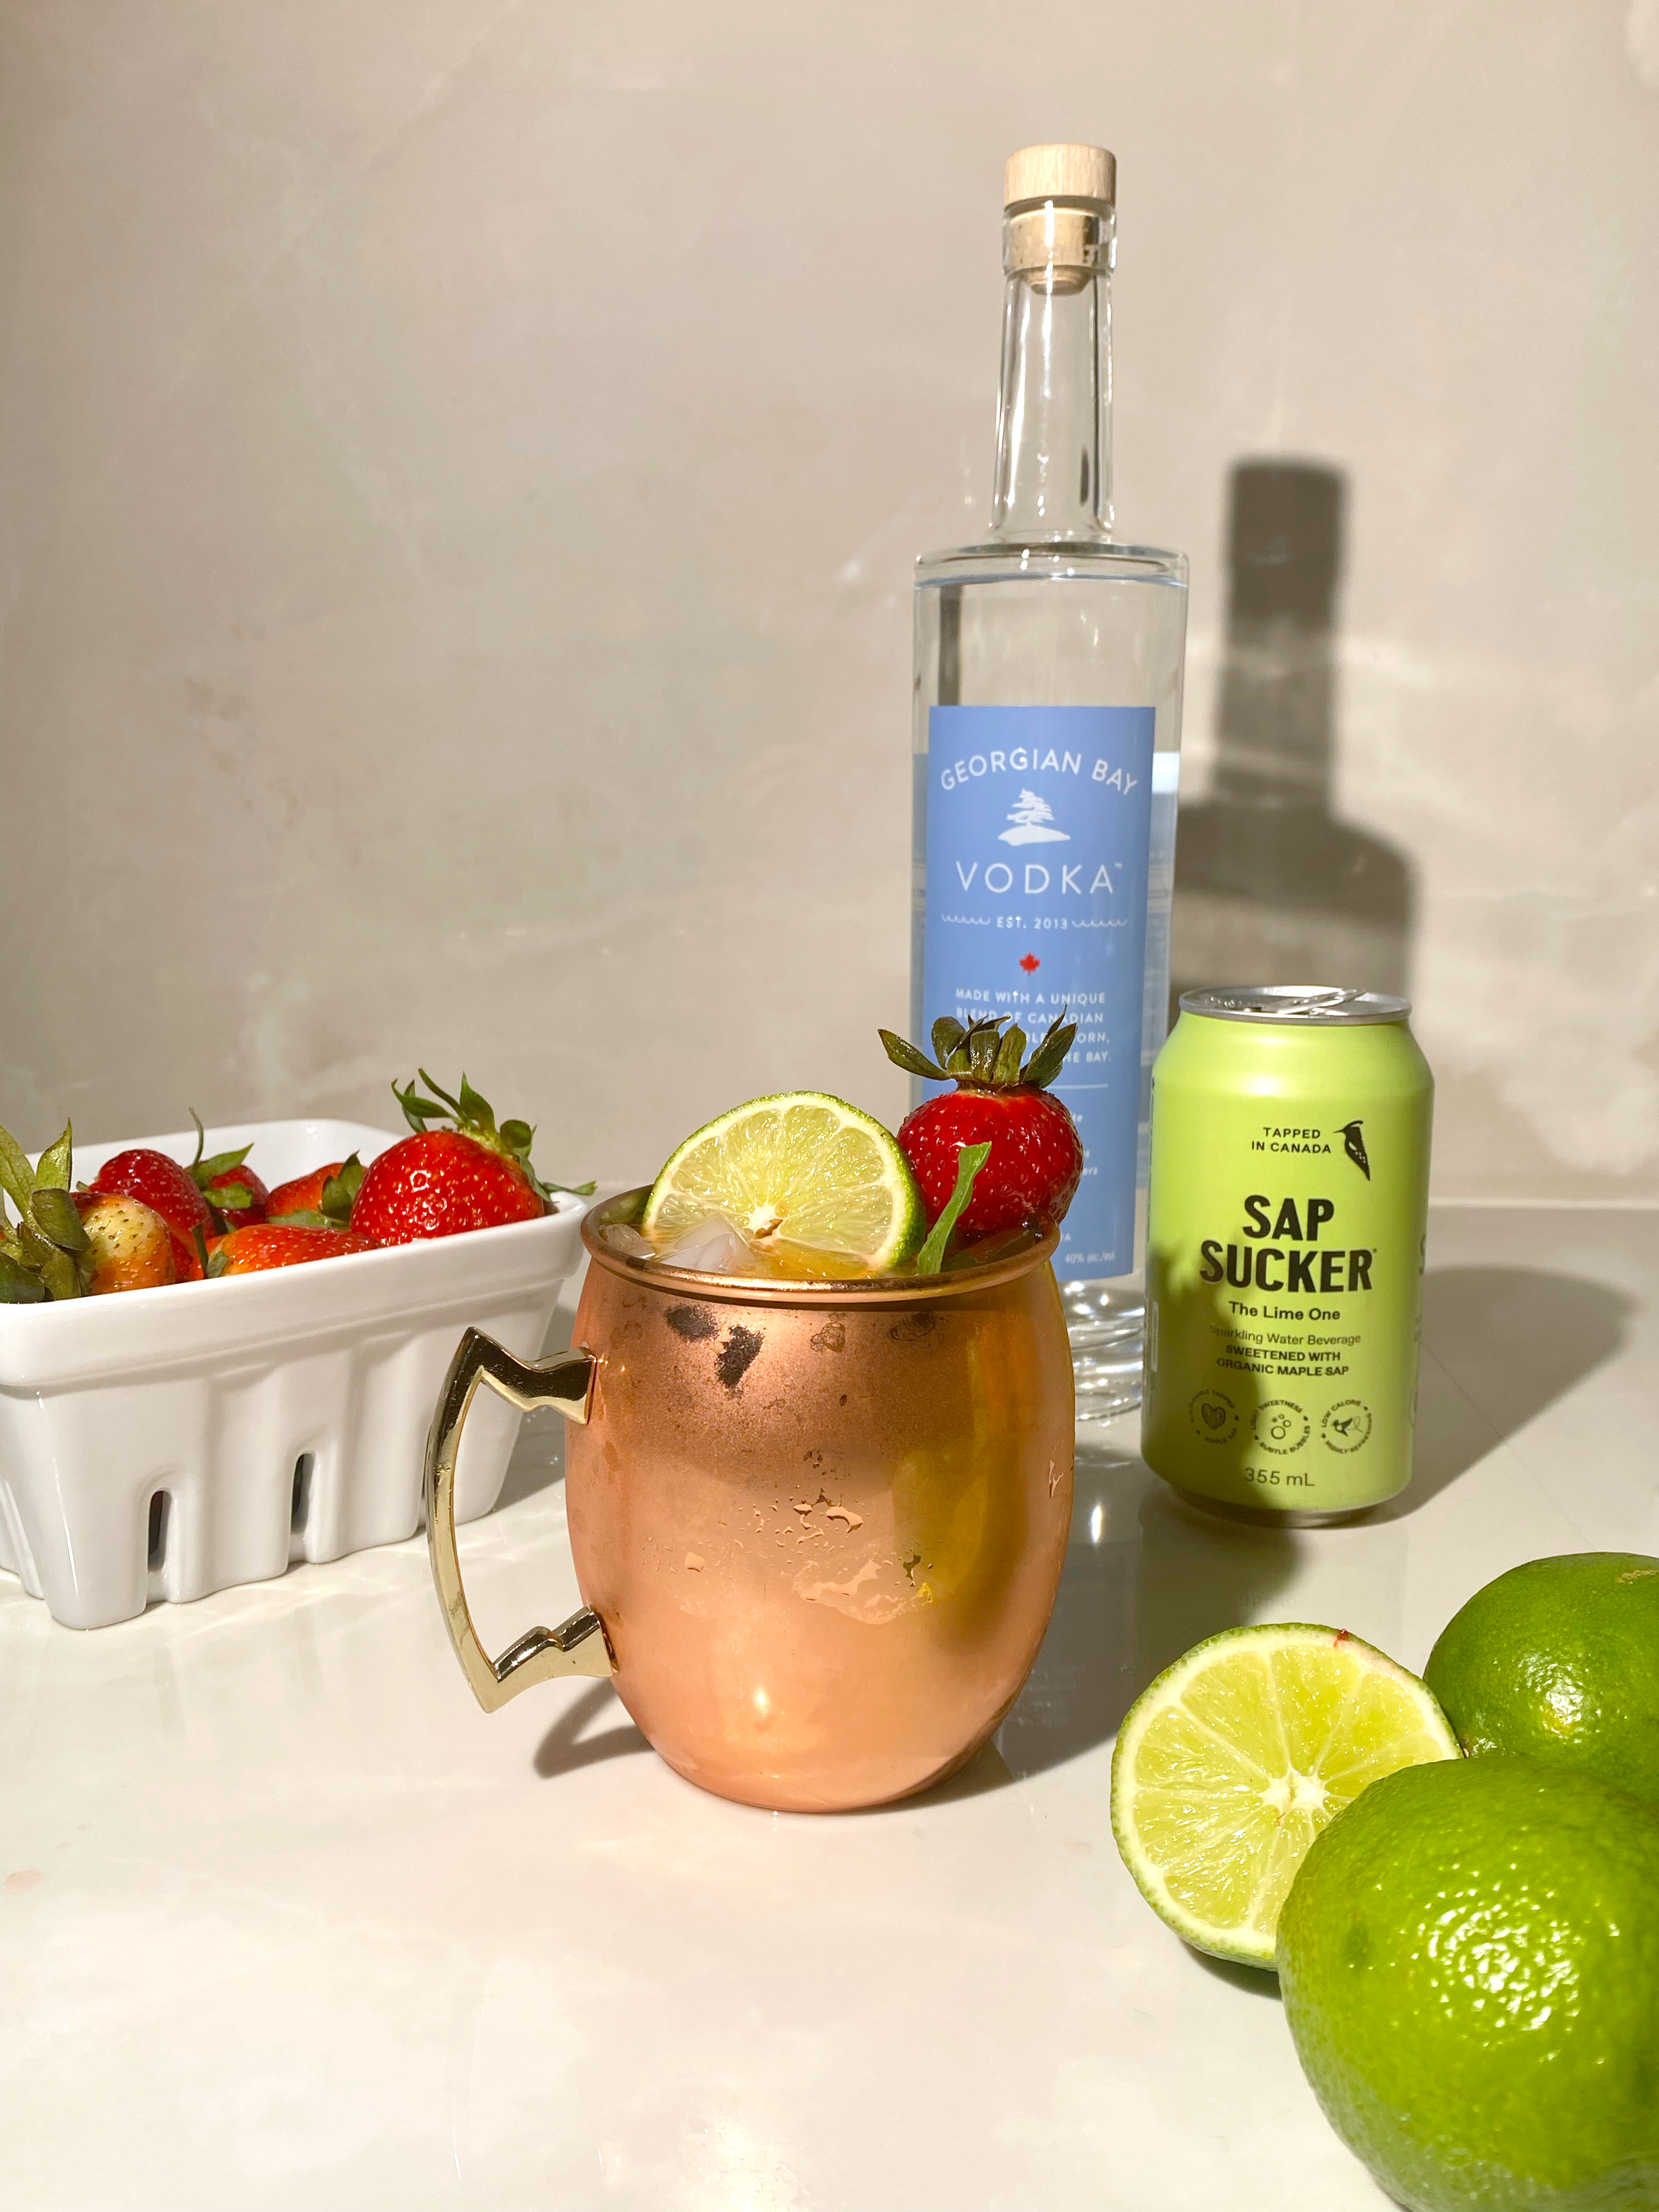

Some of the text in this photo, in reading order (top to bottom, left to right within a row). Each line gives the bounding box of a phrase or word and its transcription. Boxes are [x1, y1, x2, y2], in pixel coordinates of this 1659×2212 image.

[940, 748, 1138, 795] GEORGIAN BAY
[956, 861, 1113, 895] VODKA
[996, 917, 1068, 929] EST. 2013
[956, 988, 1106, 1006] MADE WITH A UNIQUE
[1077, 1032, 1110, 1044] ORN,
[1263, 1126, 1321, 1139] TAPPED
[1251, 1141, 1331, 1154] IN CANADA
[1243, 1194, 1335, 1241] SAP
[1200, 1239, 1373, 1293] SUCKER
[1229, 1301, 1341, 1321] The Lime One
[1209, 1323, 1361, 1346] Sparkling Water Beverage
[1226, 1345, 1341, 1362] SWEETENED WITH
[1217, 1358, 1349, 1376] ORGANIC MAPLE SAP
[1321, 1410, 1331, 1427] LOW
[1245, 1468, 1315, 1487] 355 mL
